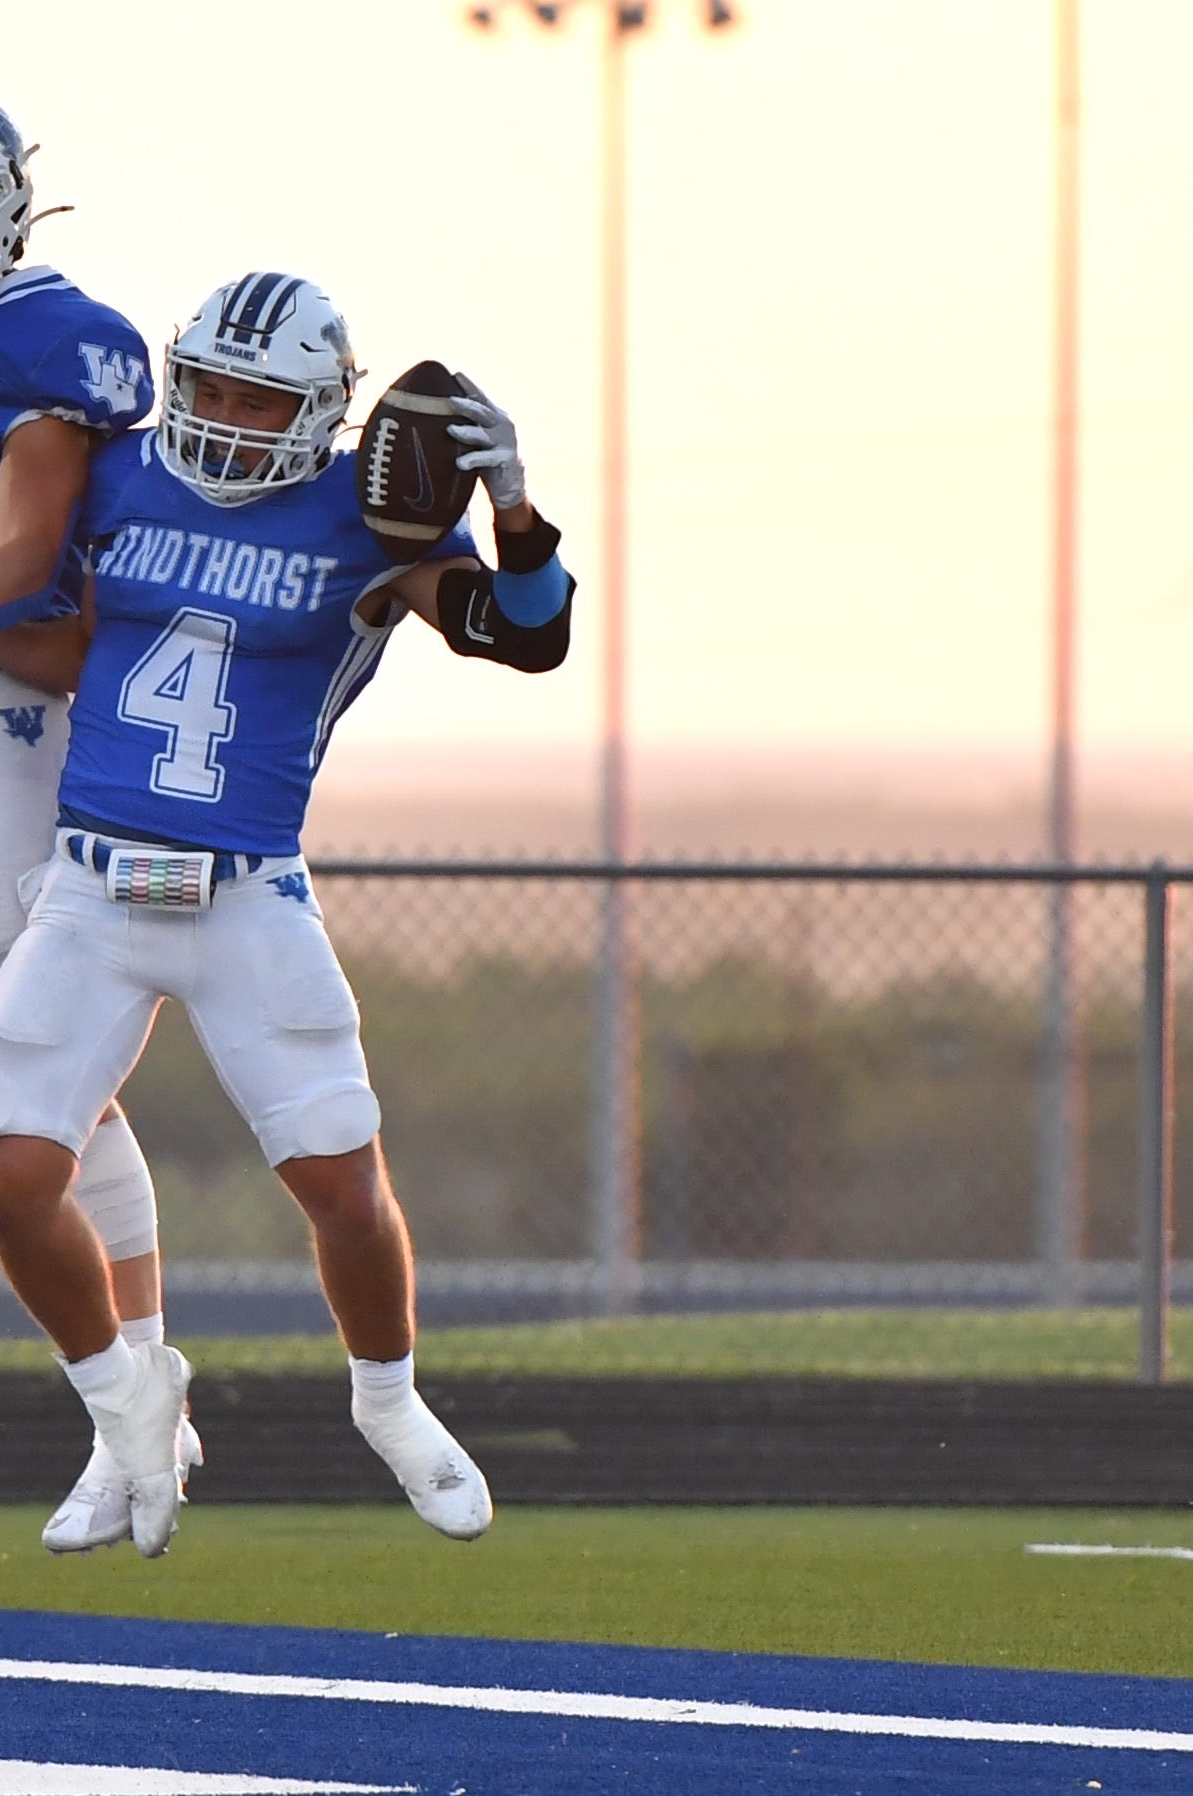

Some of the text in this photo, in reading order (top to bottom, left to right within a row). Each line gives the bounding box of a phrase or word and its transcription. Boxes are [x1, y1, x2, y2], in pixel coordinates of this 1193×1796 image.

[78, 341, 145, 415] W
[214, 342, 257, 362] TROJANS
[117, 606, 237, 803] 4
